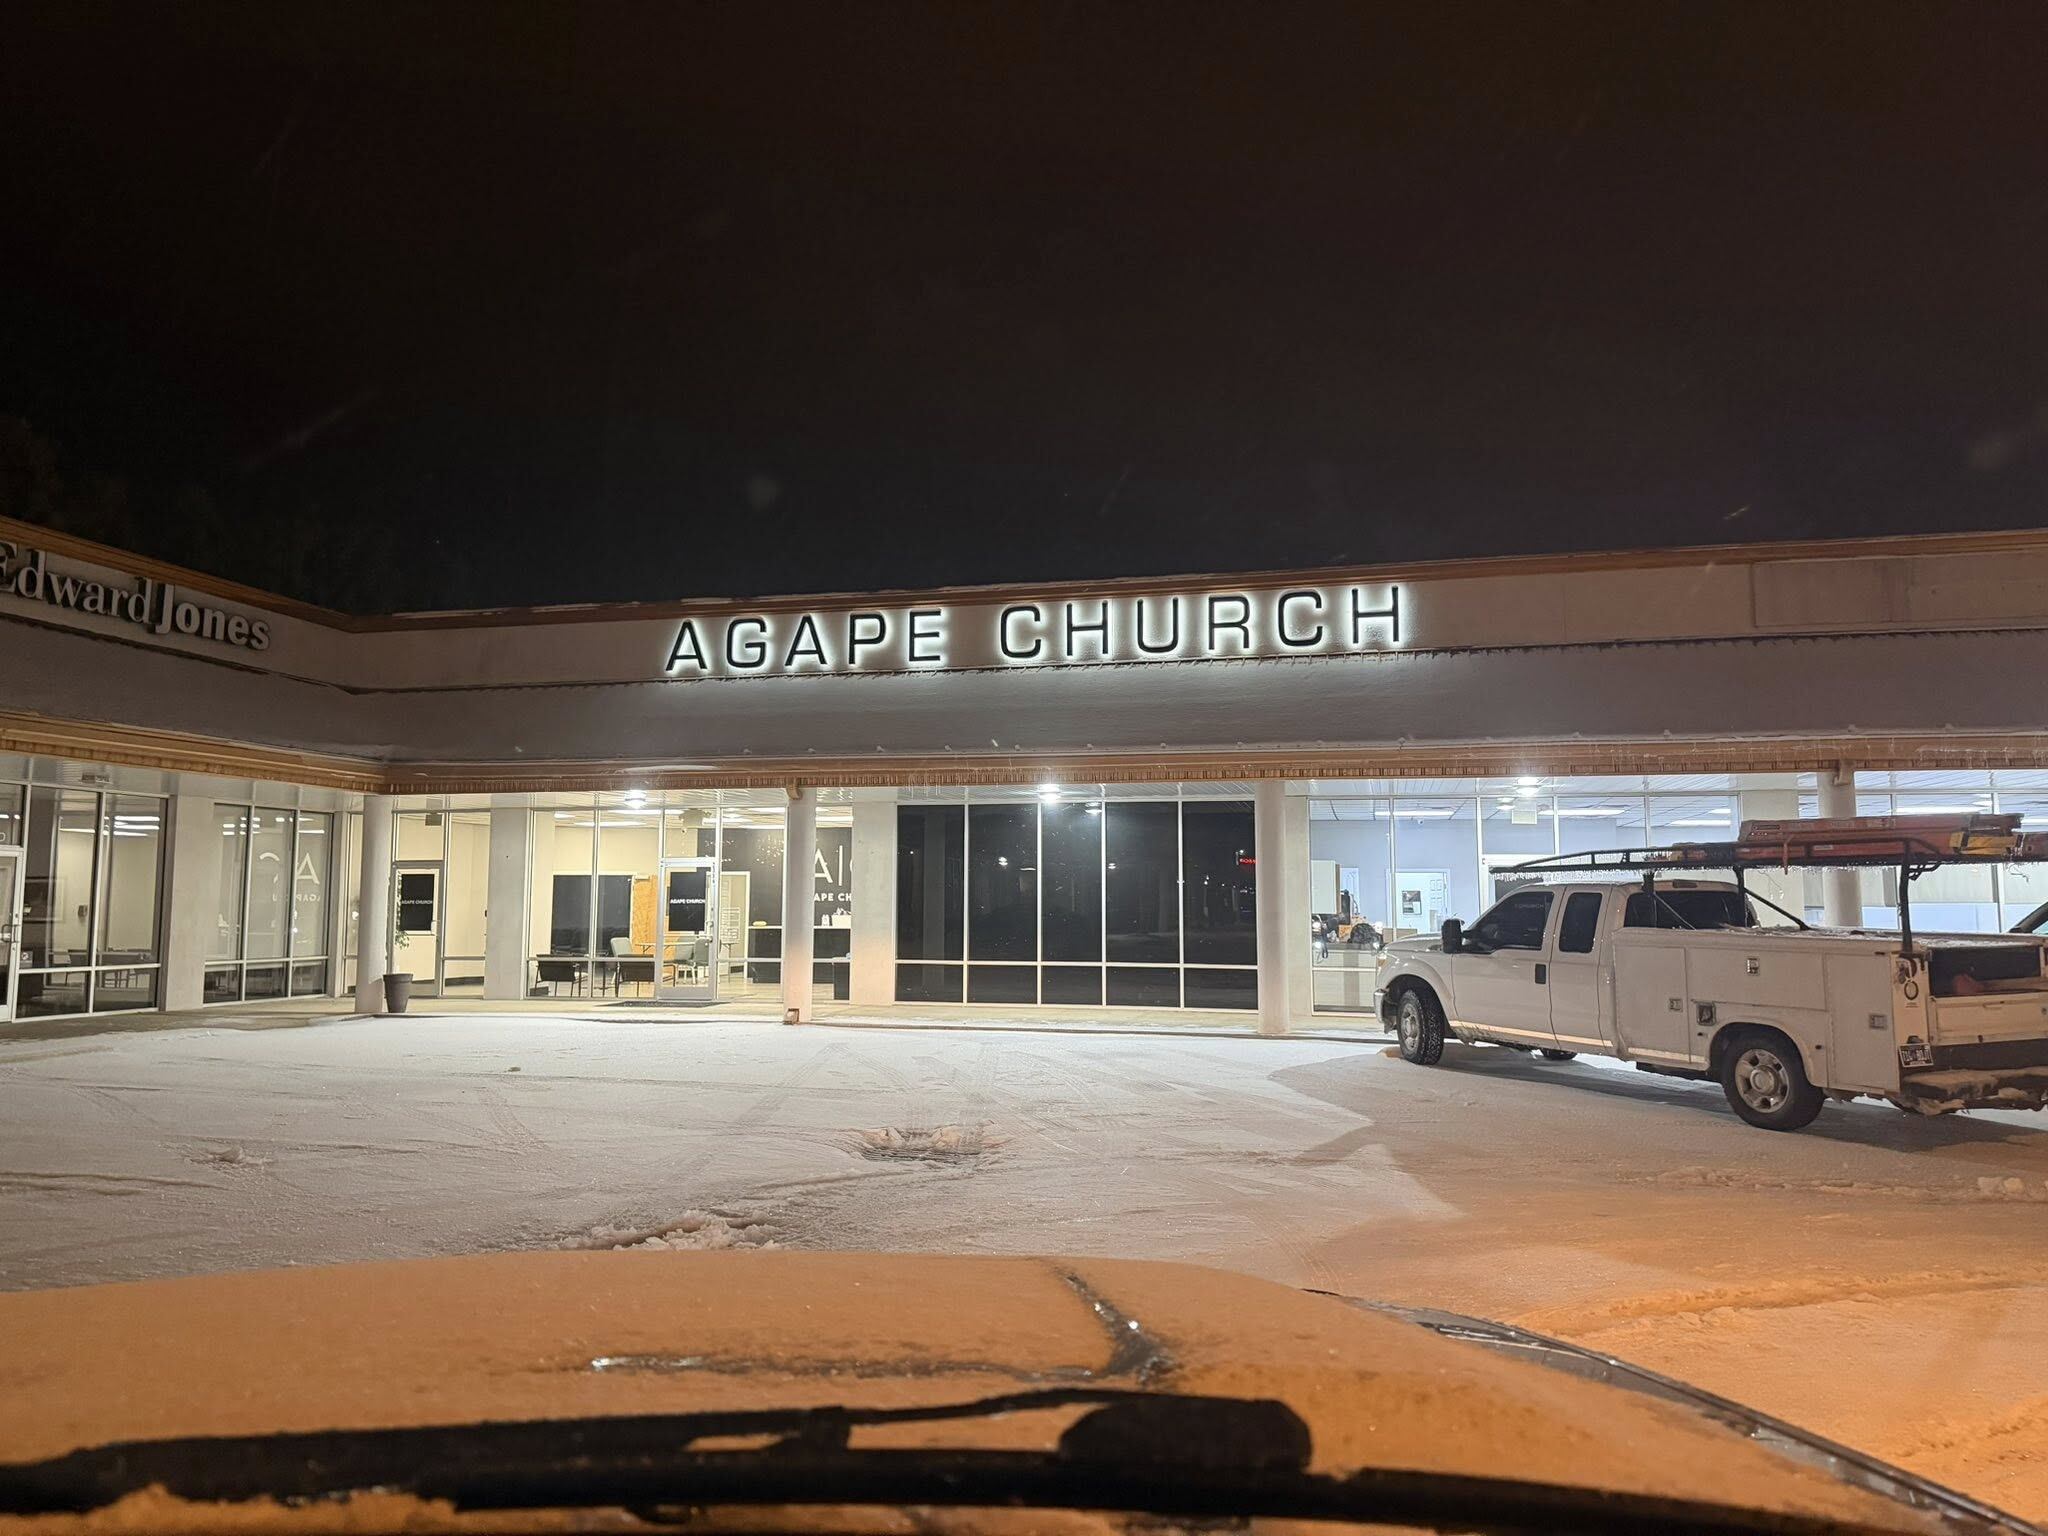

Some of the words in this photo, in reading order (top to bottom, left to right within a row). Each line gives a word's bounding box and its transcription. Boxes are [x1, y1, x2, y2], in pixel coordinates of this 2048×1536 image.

[0, 541, 151, 624] Edward
[155, 583, 271, 650] Jones
[665, 607, 943, 672] AGAPE
[1000, 585, 1400, 658] CHURCH
[814, 892, 834, 902] APE
